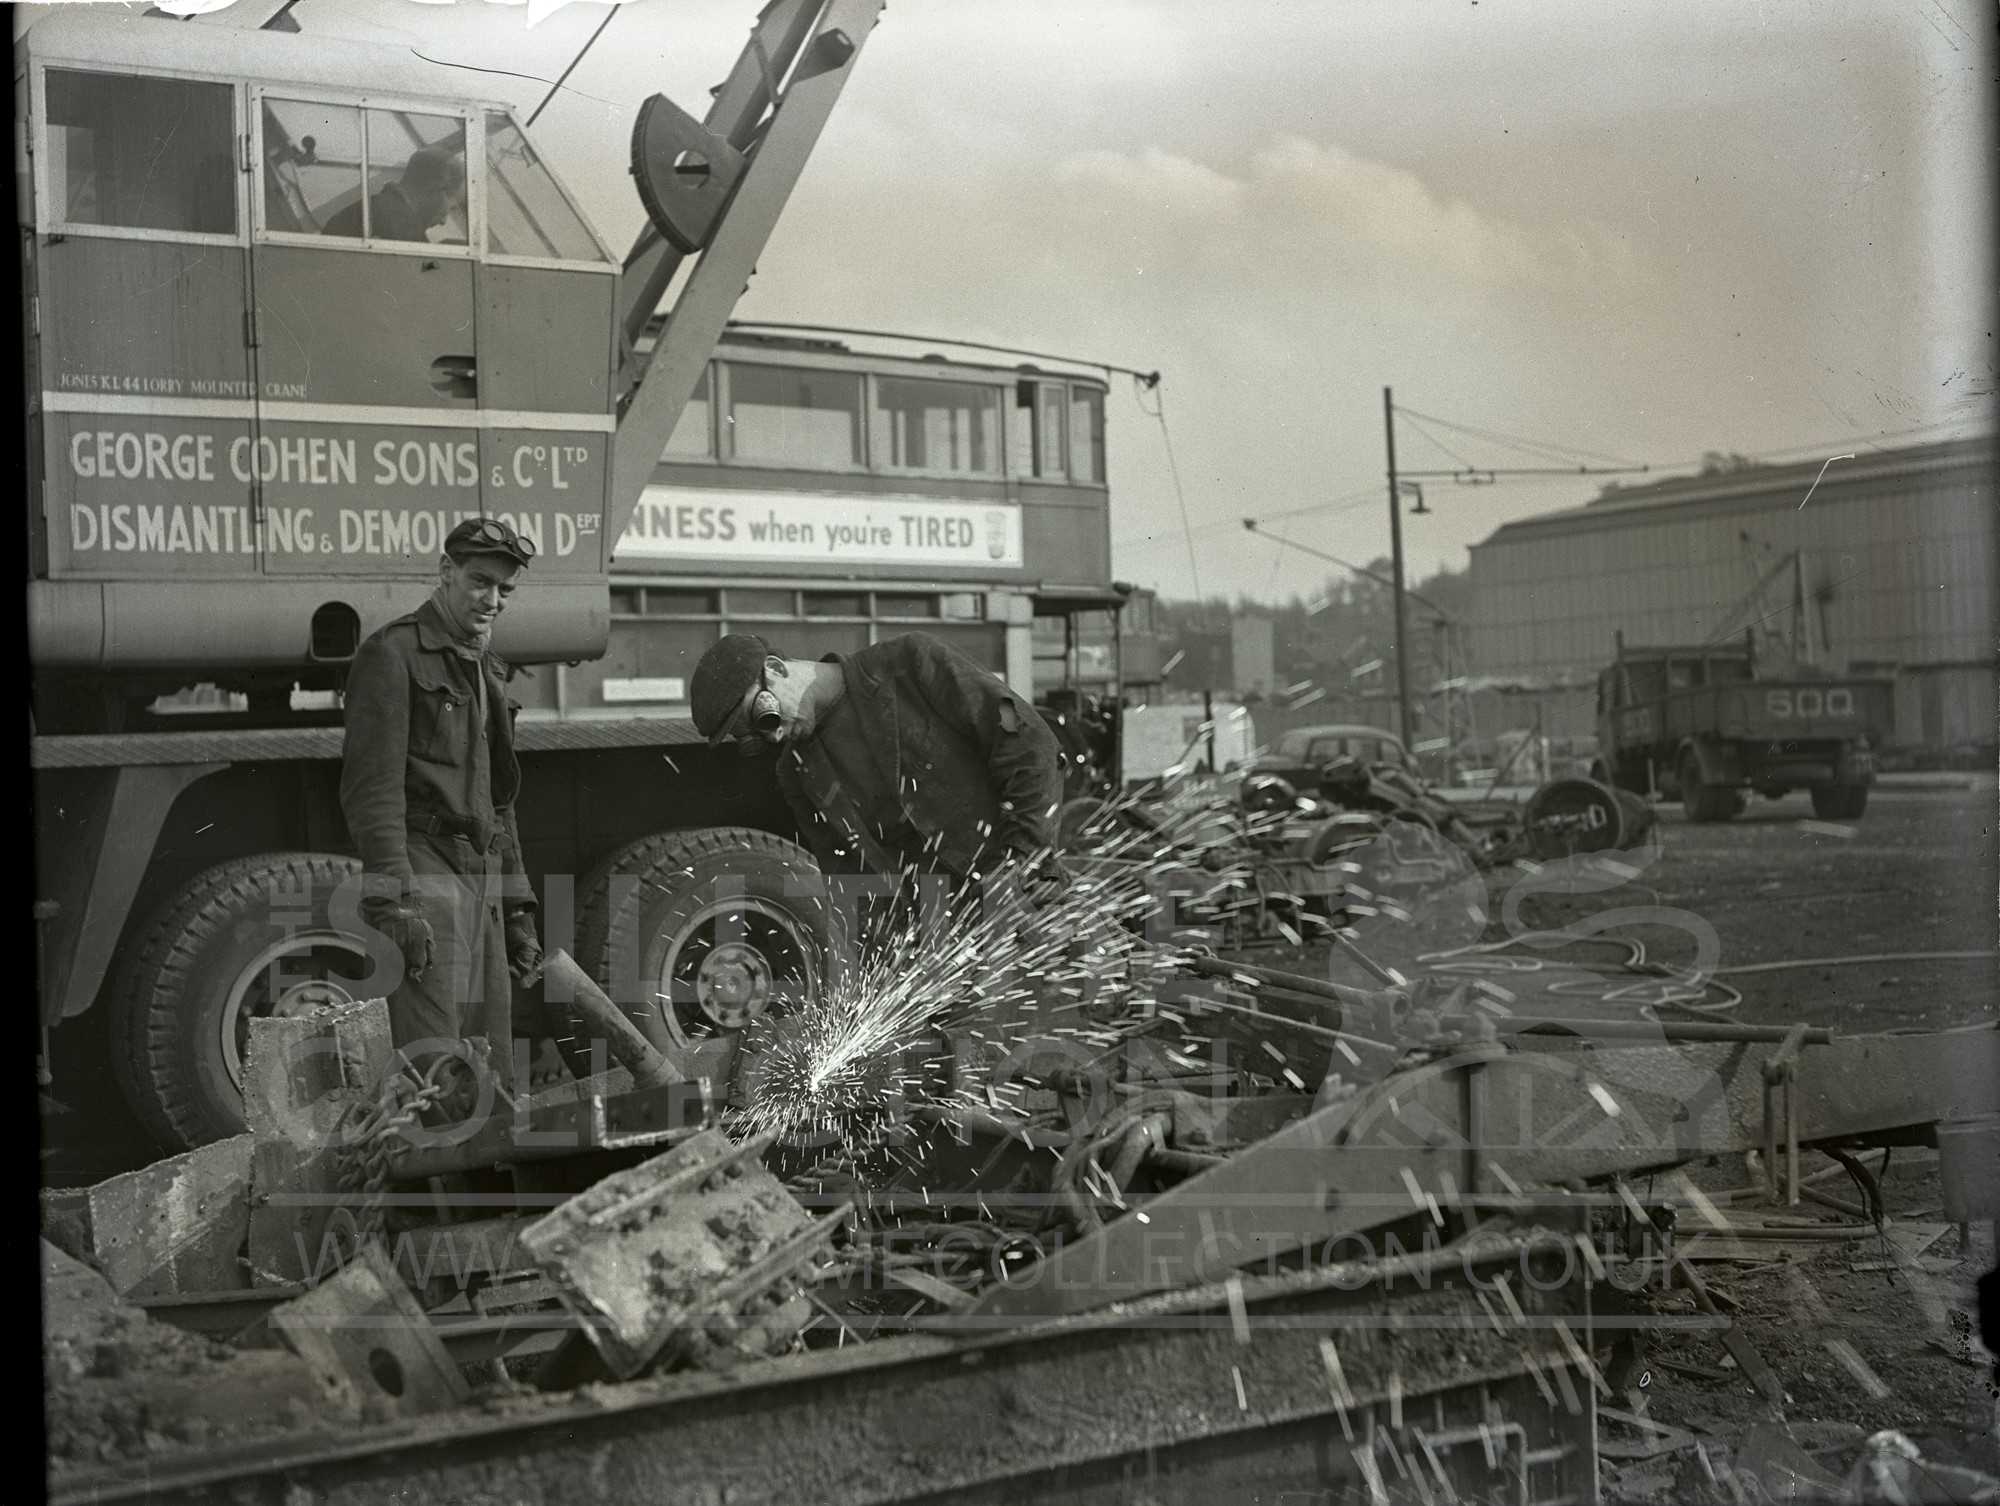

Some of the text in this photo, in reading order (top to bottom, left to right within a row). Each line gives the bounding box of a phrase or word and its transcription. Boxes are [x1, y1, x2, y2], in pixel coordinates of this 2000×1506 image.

[143, 377, 184, 394] LORRY
[265, 382, 308, 399] CRANE
[71, 431, 214, 481] GEORGE
[229, 435, 357, 485] COHEN
[373, 440, 480, 488] SONS
[491, 464, 505, 488] &
[70, 504, 315, 554] DISMANTLING
[319, 533, 334, 554] &
[749, 509, 814, 543] when
[899, 515, 974, 548] TIRED
